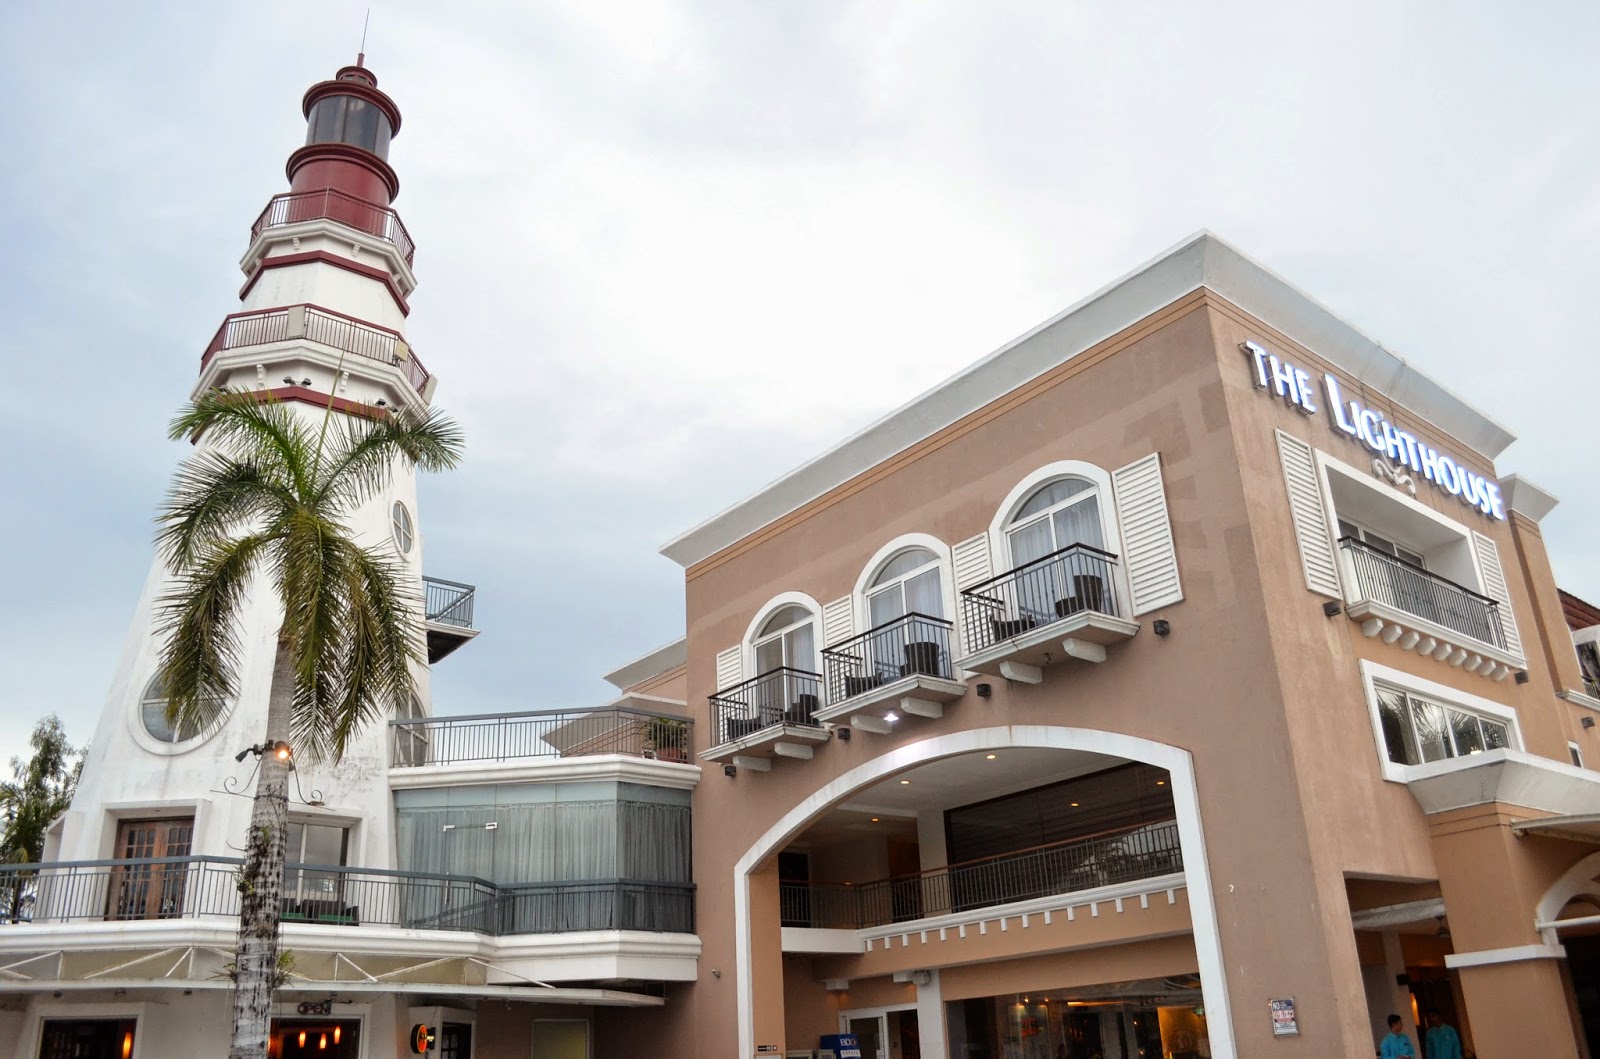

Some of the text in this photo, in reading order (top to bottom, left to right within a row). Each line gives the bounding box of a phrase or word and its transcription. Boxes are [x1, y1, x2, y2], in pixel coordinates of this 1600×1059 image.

[1239, 340, 1504, 521] THE LIGHTHOUSE
[298, 1001, 330, 1015] OPEN
[840, 1038, 856, 1046] BDO
